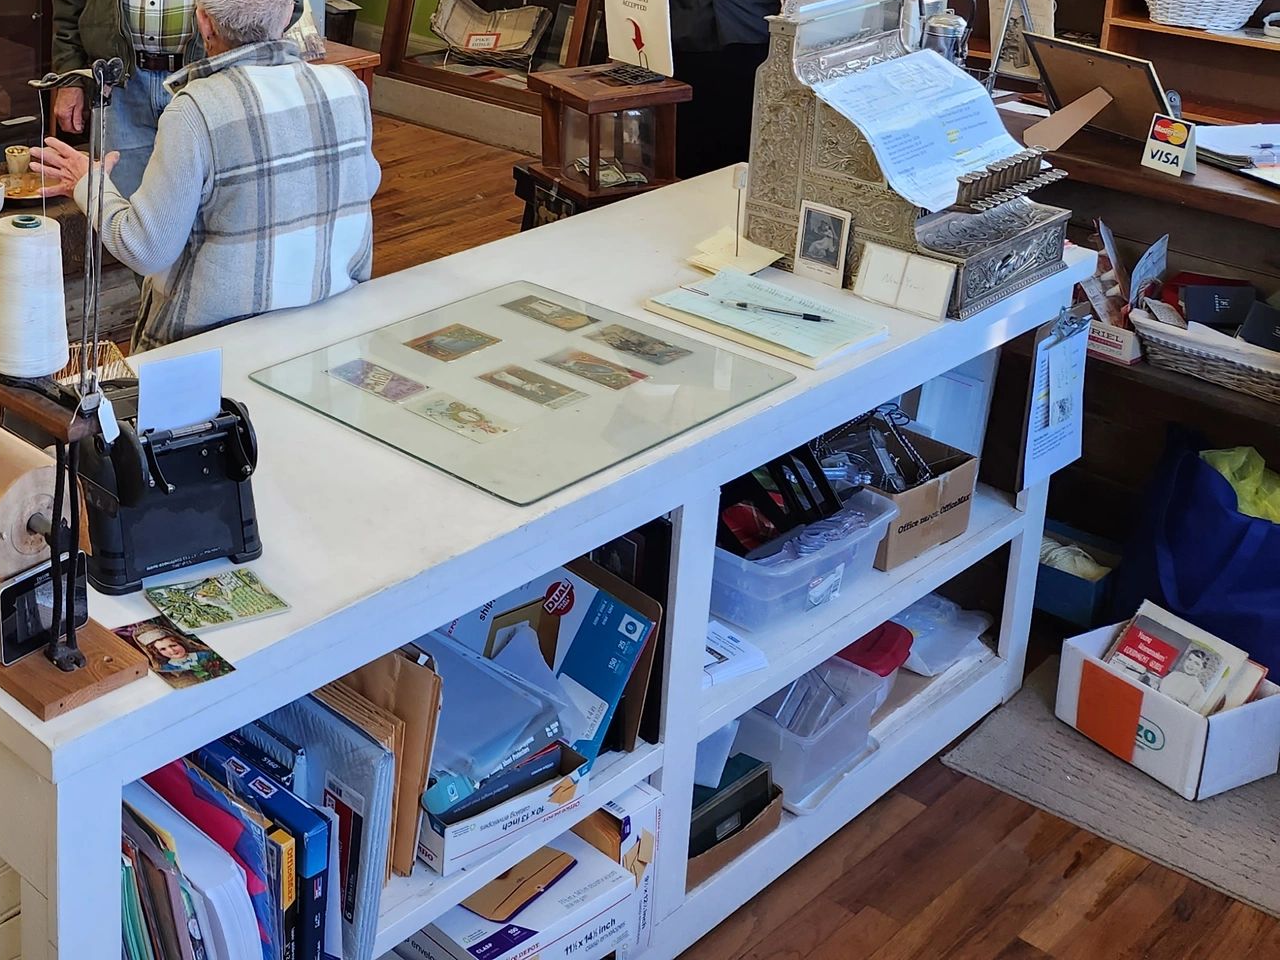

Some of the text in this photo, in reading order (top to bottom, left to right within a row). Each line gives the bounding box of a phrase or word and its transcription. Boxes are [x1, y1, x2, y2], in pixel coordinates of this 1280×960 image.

[623, 0, 647, 12] ACCEPTED
[1150, 149, 1179, 167] VISA
[897, 520, 919, 534] Office
[940, 493, 971, 514] OfficeMax
[544, 582, 570, 612] DUAL
[1138, 631, 1152, 644] Young
[608, 640, 626, 670] 150 25
[1123, 646, 1164, 672] EQUIPMENT GUIDE
[520, 812, 530, 824] 13
[536, 805, 545, 817] 10
[479, 814, 510, 832] envelopes
[502, 818, 520, 832] inch
[286, 846, 294, 902] OfficeMax
[598, 919, 616, 931] inch
[476, 942, 493, 954] CLASP
